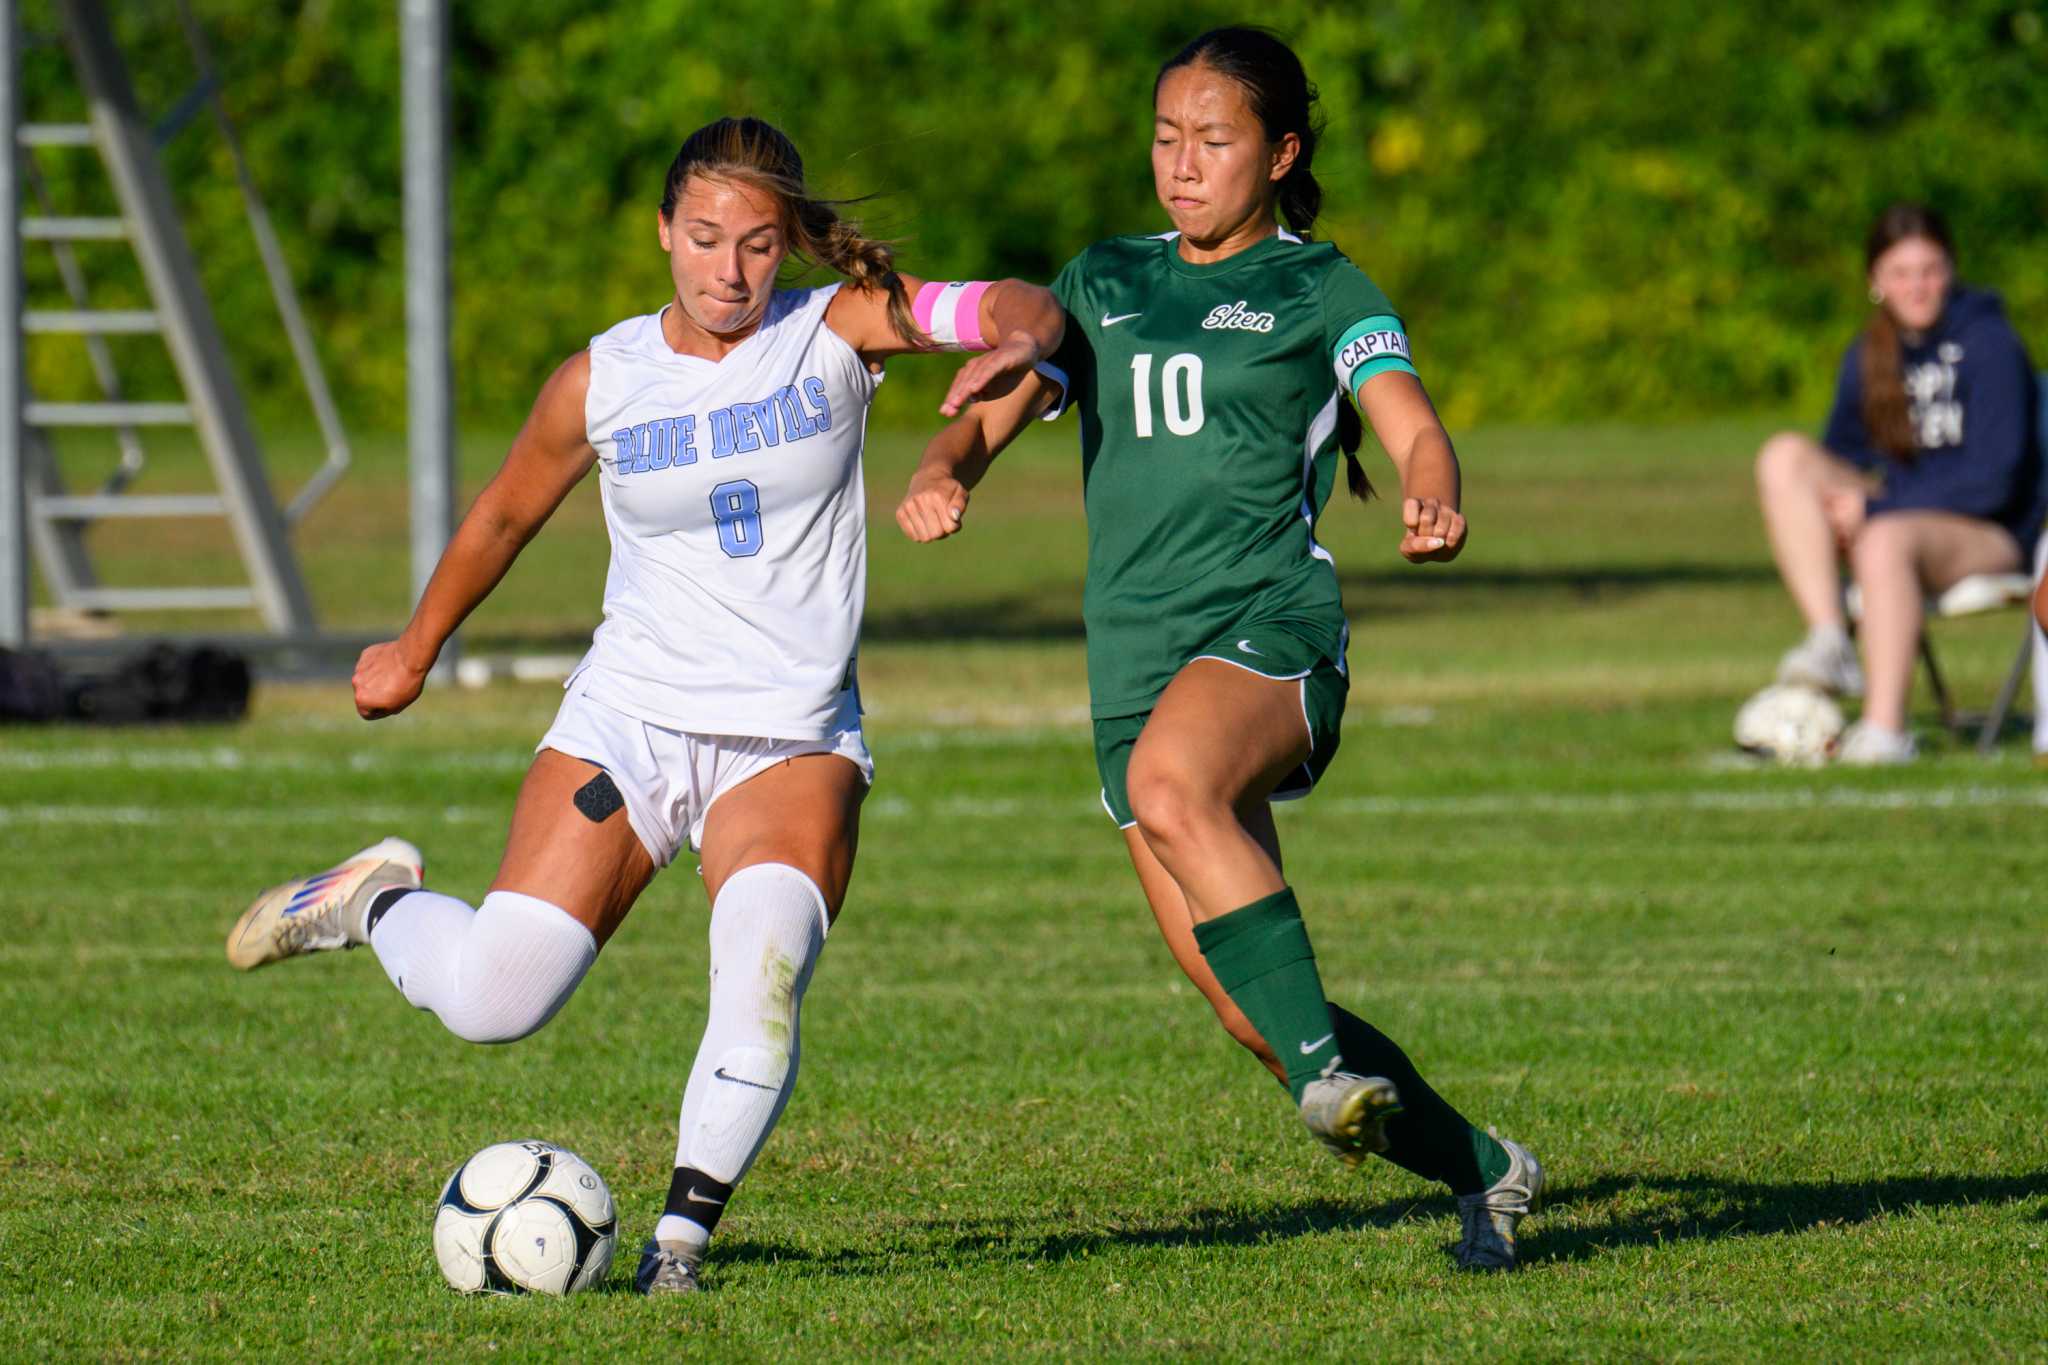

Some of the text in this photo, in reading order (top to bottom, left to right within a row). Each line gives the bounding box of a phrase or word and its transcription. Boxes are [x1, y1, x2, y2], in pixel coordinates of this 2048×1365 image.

[1201, 300, 1274, 333] Shen
[611, 376, 832, 475] BLUE DEVILS
[1130, 353, 1205, 438] 10
[709, 478, 763, 559] 8
